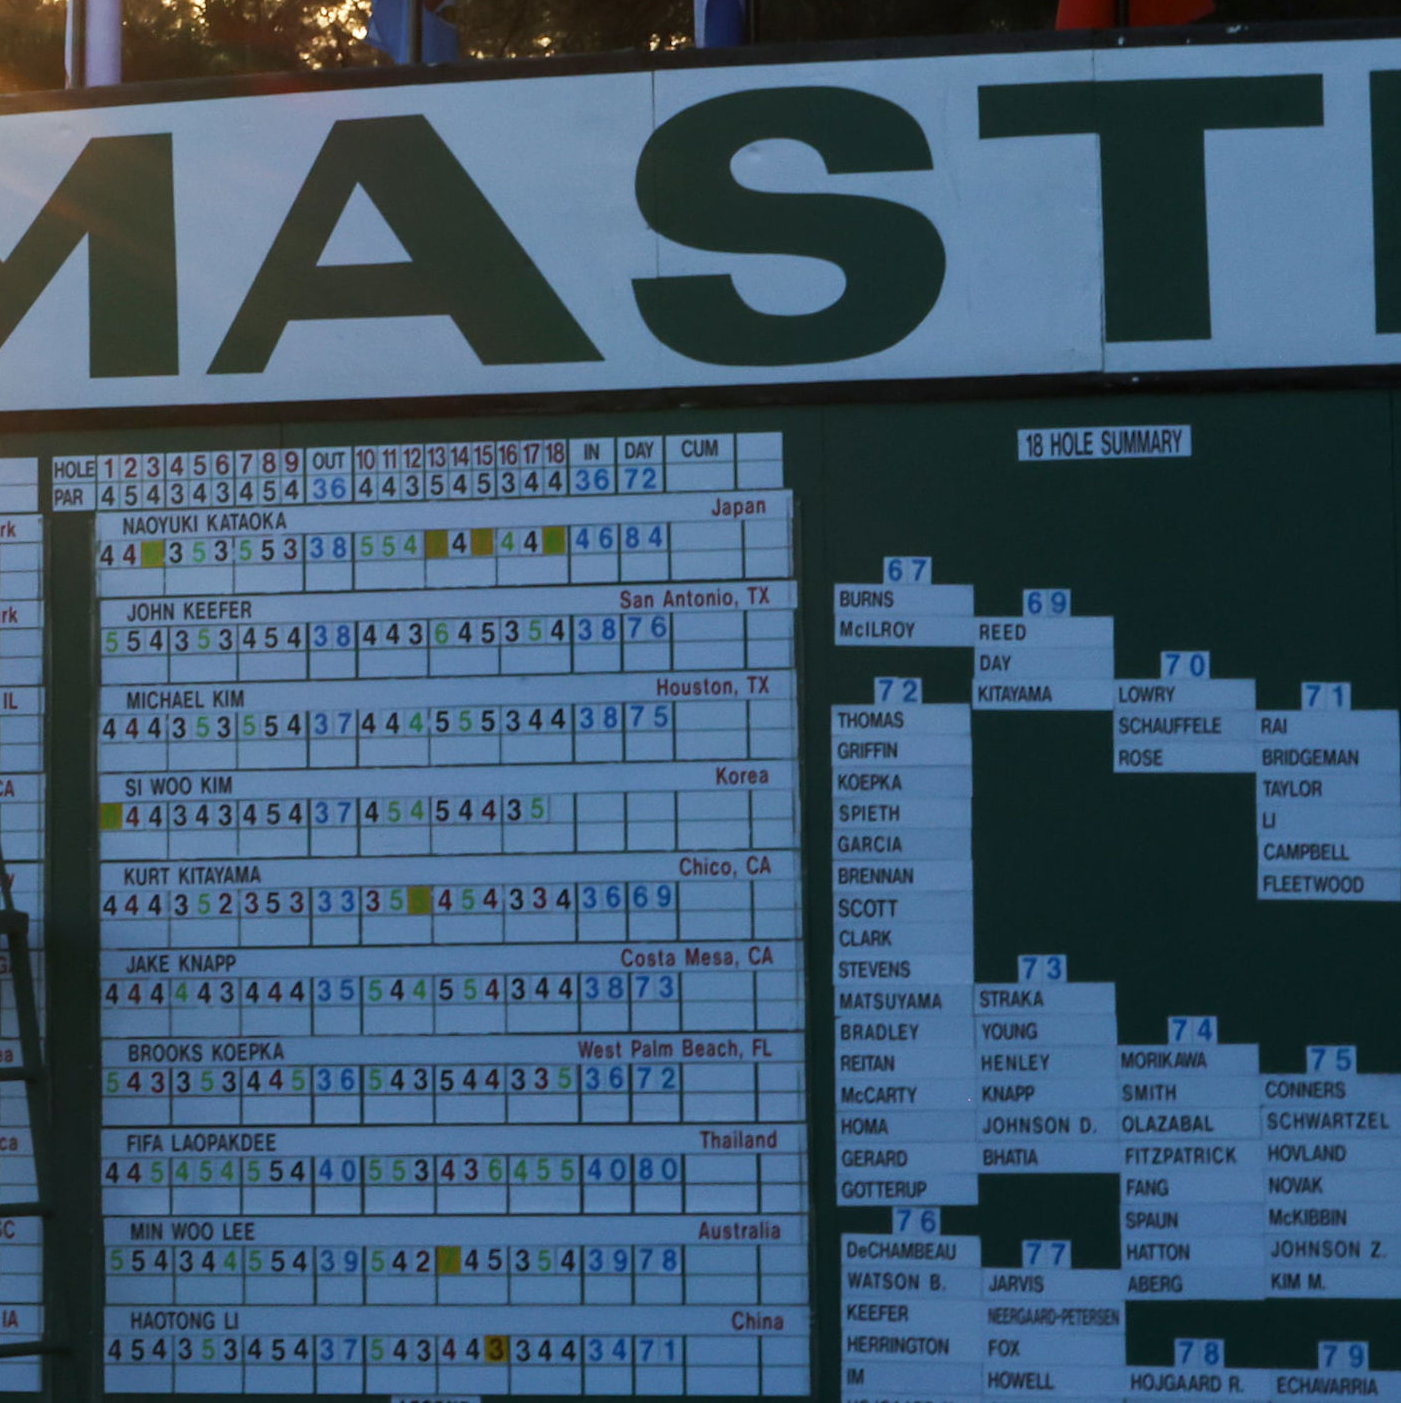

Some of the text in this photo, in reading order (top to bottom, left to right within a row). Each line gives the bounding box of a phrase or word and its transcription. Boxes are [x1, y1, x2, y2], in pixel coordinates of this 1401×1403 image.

[1025, 428, 1182, 457] 18 HOLE SUMMARY
[54, 439, 719, 478] HOLE OUT IN DAY CUM
[54, 488, 83, 506] PAR
[710, 497, 766, 520] Japan
[122, 511, 287, 535] NAOYUKI KATAOKA
[839, 589, 894, 608] BURNS
[126, 600, 251, 622] JOHN KEEFER
[839, 620, 915, 639] McILROY
[979, 623, 1026, 641] REED
[126, 689, 244, 710] MICHAEL KIM
[977, 684, 1052, 702] KITAYAMA
[1118, 685, 1174, 704] LOWRY
[837, 710, 904, 729] THOMAS
[1118, 715, 1221, 735] SCHAUFFELE
[1118, 748, 1163, 767] ROSE
[1261, 747, 1358, 766] BRIDGEMAN
[124, 775, 232, 797] SI WOO KIM
[1261, 778, 1322, 798] TAYLOR
[838, 803, 900, 822] SPIETH
[123, 865, 261, 886] KURT KITAYAMA
[837, 866, 913, 884] BRENNAN
[1262, 874, 1364, 894] FLEETWOOD
[837, 897, 895, 918] SCOTT
[126, 953, 236, 974] JAKE KNAPP
[839, 991, 942, 1010] MATSUYAMA
[979, 989, 1044, 1008] STRAKA
[840, 1022, 919, 1041] BRADLEY
[981, 1021, 1038, 1041] YOUNG
[127, 1041, 284, 1062] BROOKS KOEPKA
[980, 1053, 1049, 1071] HENLEY
[1122, 1083, 1176, 1102] SMITH
[1264, 1079, 1346, 1099] CONNERS
[1121, 1114, 1214, 1133] OLAZABAL
[1265, 1110, 1390, 1131] SCHWARTZEL
[126, 1132, 276, 1152] FIFA LAOPAKDEE
[699, 1129, 777, 1149] Thailand
[1124, 1145, 1236, 1165] FITZPATRICK
[1267, 1143, 1347, 1162] HOVLAND
[130, 1221, 255, 1241] MIN WOO LEE
[697, 1220, 780, 1240] Australia
[845, 1240, 956, 1260] DeCHAMBEAU
[988, 1274, 1044, 1294] JARVIS
[130, 1310, 239, 1330] HAOTONG LI
[846, 1303, 908, 1322] KEEFER
[1276, 1375, 1377, 1395] ECHAVARRIA
